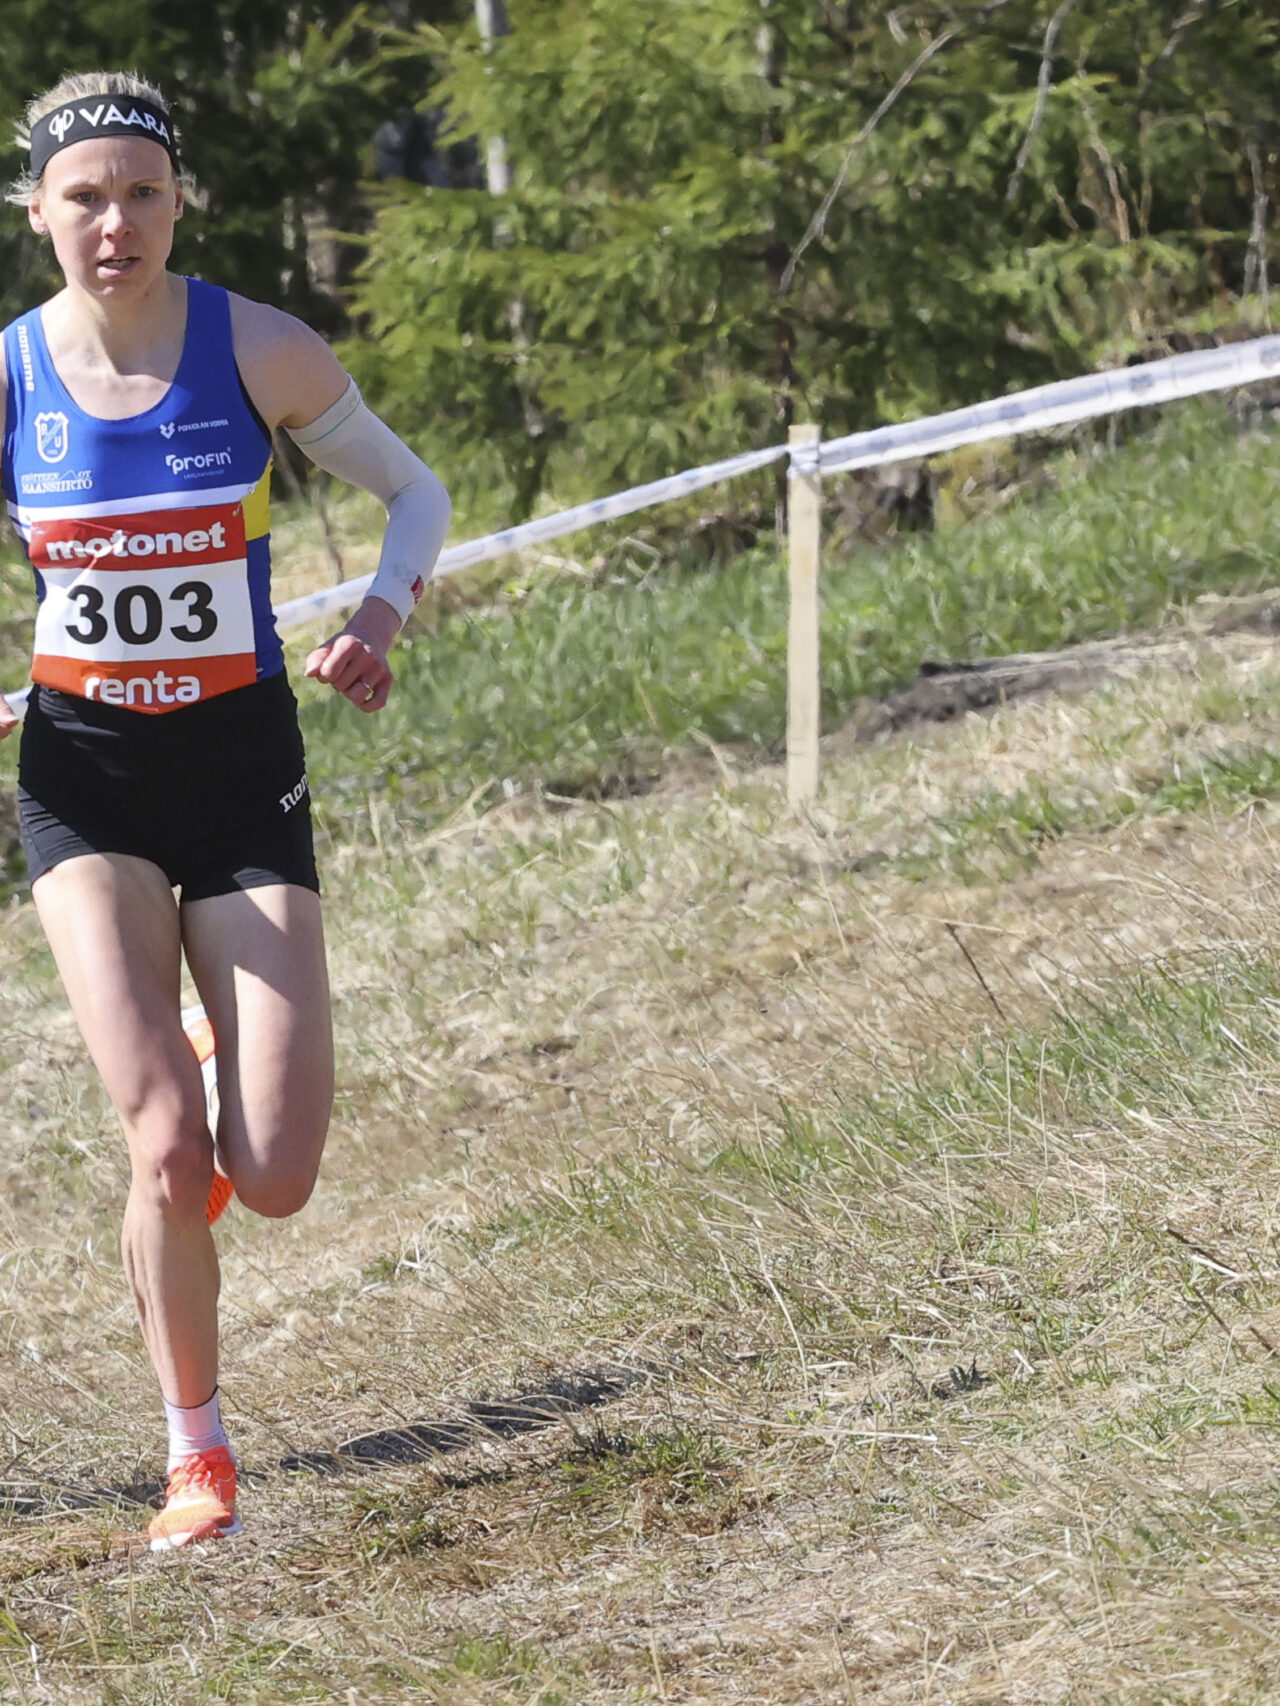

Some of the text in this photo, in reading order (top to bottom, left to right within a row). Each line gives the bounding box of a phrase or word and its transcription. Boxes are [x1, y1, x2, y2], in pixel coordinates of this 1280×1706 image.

[78, 103, 171, 146] VAARA
[45, 520, 227, 562] motonet
[64, 580, 219, 646] 303
[84, 670, 202, 706] renta
